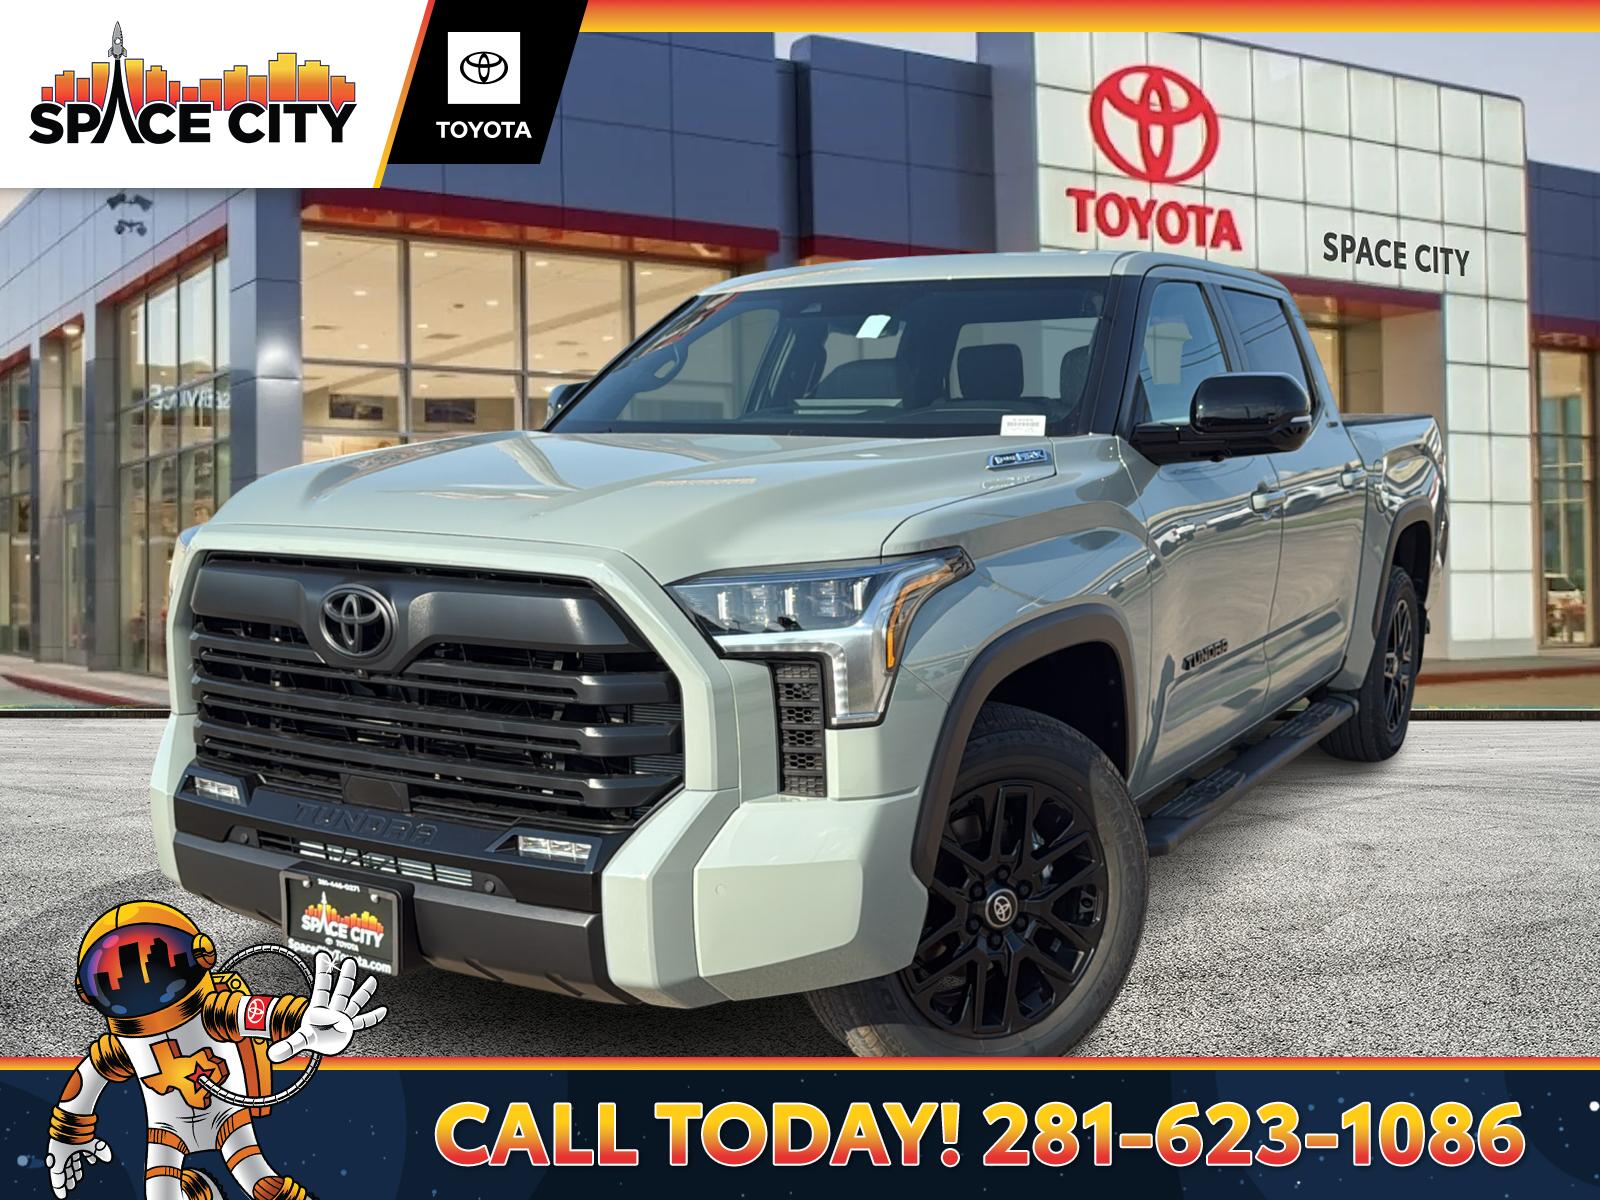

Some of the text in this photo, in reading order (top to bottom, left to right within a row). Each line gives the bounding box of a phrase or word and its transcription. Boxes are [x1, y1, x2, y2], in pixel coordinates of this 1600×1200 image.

[1066, 187, 1242, 251] TOYOTA
[1323, 231, 1470, 277] SPACE CITY
[1182, 638, 1228, 670] TUNDRA
[295, 801, 437, 845] TUNDRA
[301, 902, 384, 948] SPACE CITY
[335, 939, 359, 952] TOYOTA
